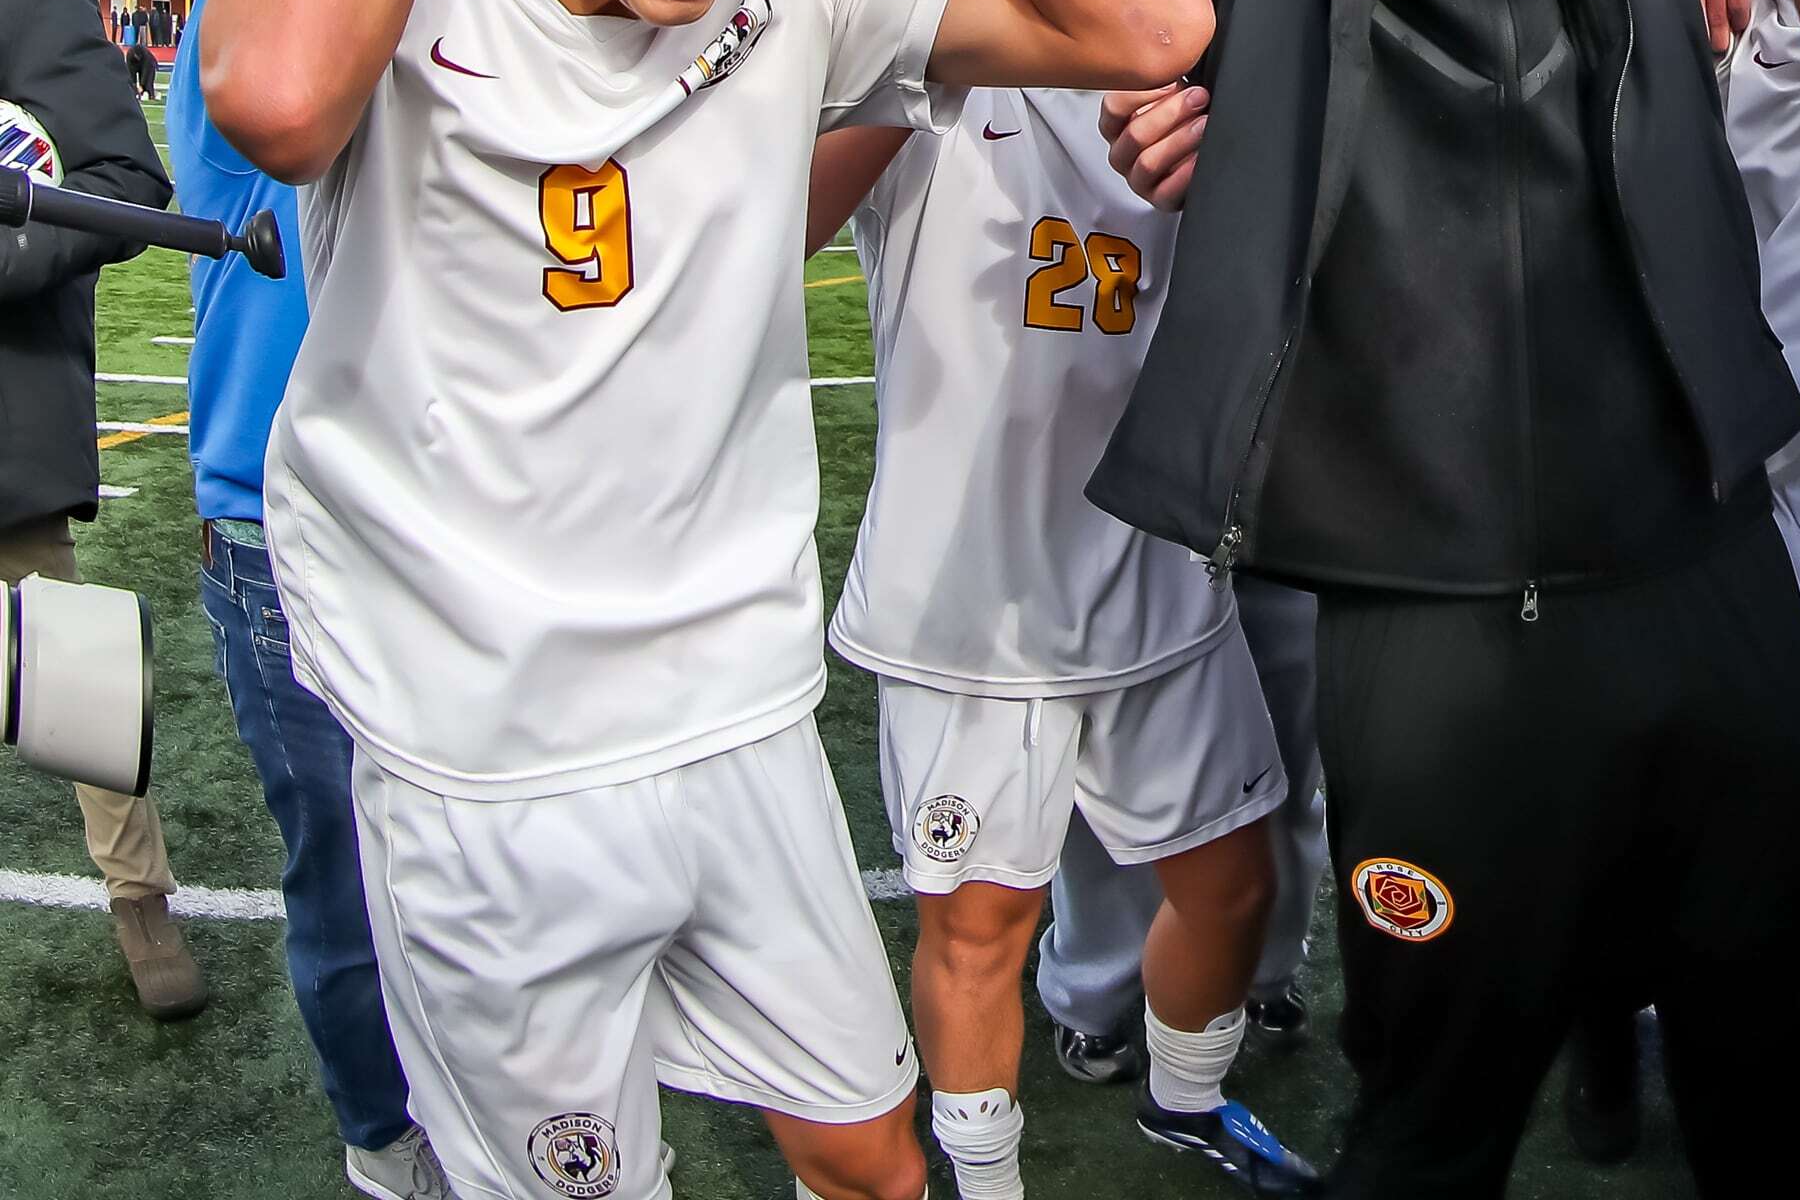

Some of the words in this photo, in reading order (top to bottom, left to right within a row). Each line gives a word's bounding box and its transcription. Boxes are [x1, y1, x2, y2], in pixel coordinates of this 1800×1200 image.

[538, 156, 634, 312] 9
[1024, 216, 1141, 335] 28
[927, 799, 970, 816] MADISON
[921, 842, 965, 858] DODGERS
[541, 1119, 602, 1139] MADISON
[555, 1174, 614, 1195] DODGERS
